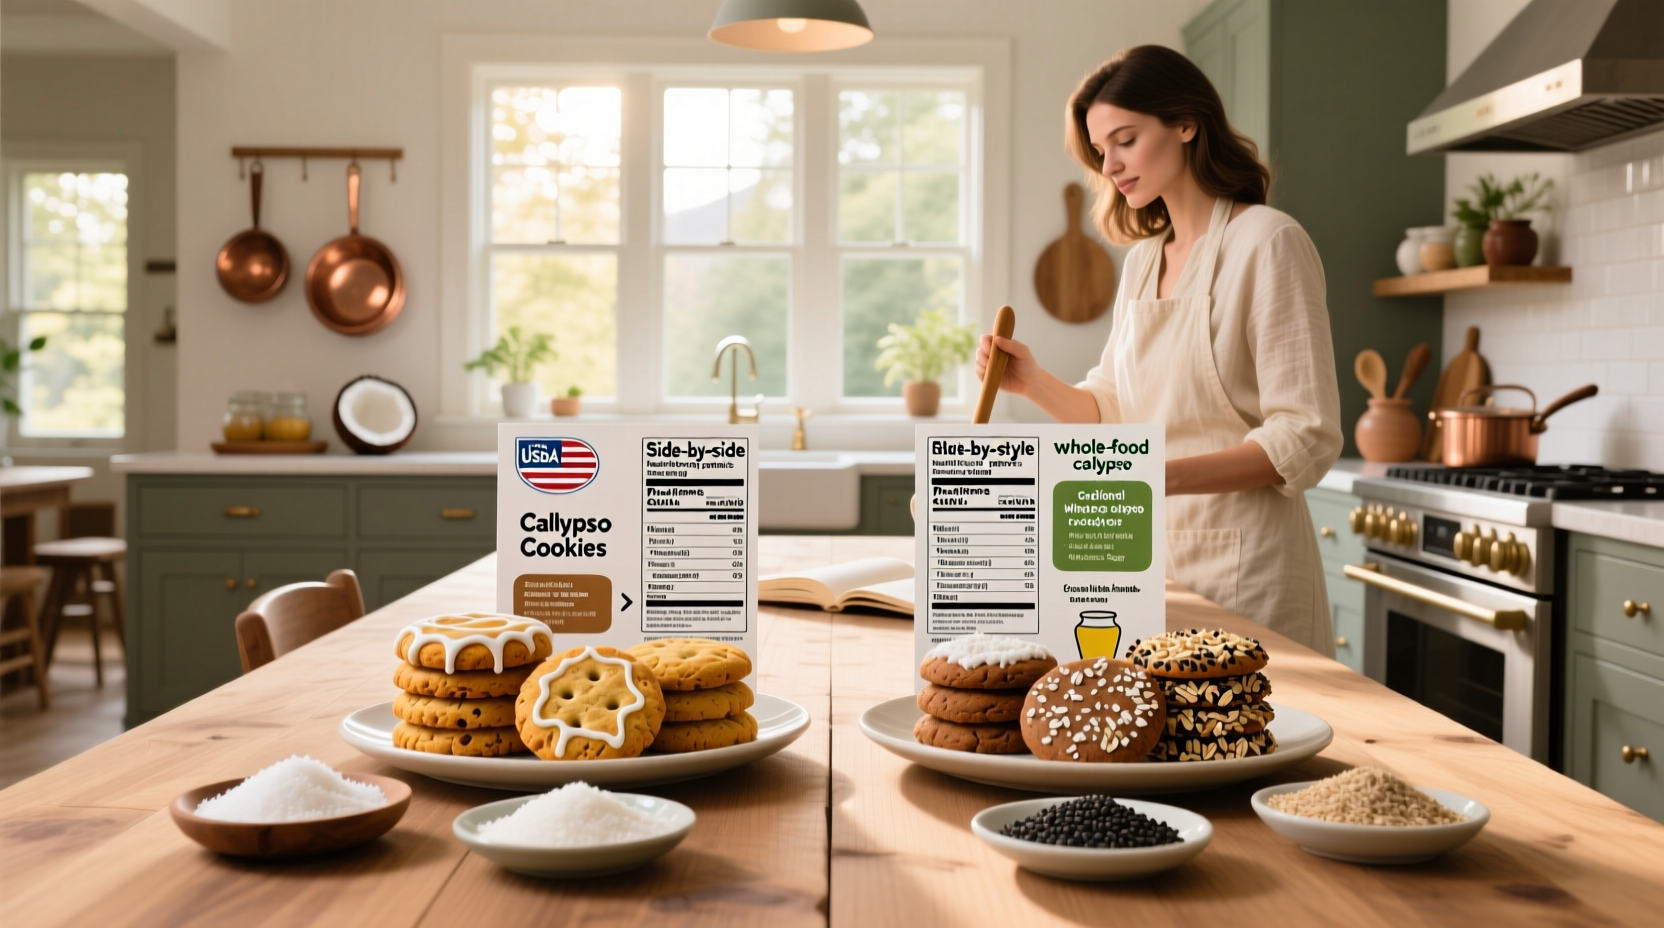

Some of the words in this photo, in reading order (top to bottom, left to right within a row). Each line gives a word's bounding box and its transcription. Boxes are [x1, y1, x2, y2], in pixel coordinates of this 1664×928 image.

[521, 444, 559, 464] USDA
[646, 441, 746, 462] Side-by-side
[1053, 438, 1149, 455] whole-food
[520, 512, 612, 538] Callypso
[520, 537, 607, 557] Cookies
